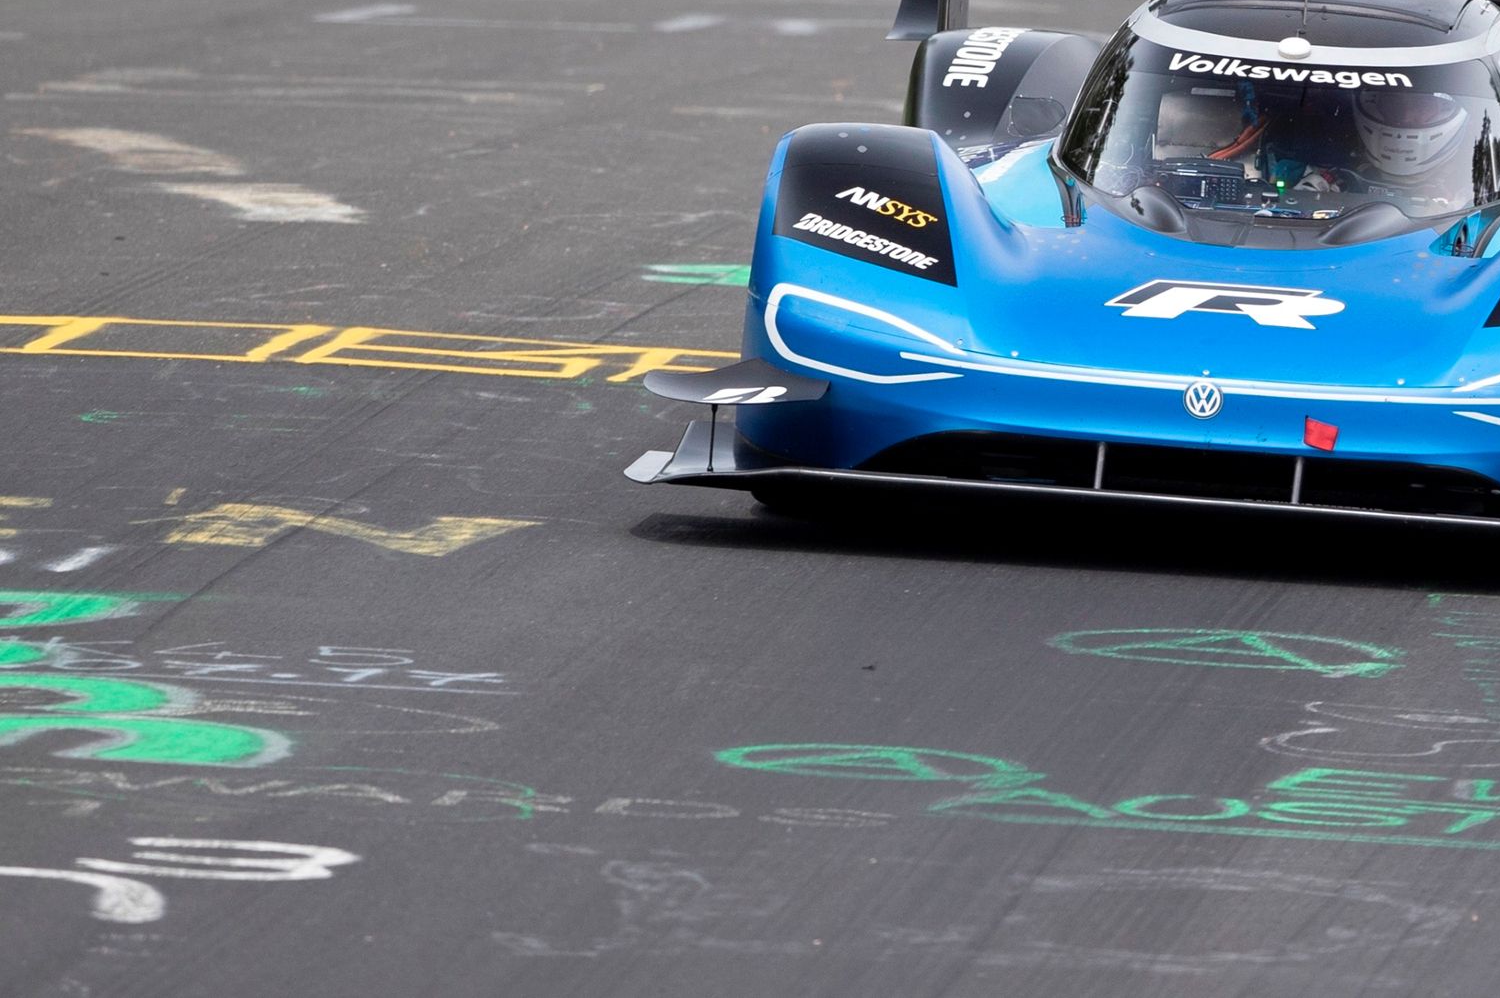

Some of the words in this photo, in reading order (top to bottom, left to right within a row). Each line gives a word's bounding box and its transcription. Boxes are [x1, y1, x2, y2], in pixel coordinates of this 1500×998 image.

[1168, 52, 1414, 89] Volkswagen
[835, 186, 937, 228] ANSYS
[792, 212, 939, 270] BRIDGESTONE
[1104, 279, 1346, 330] R
